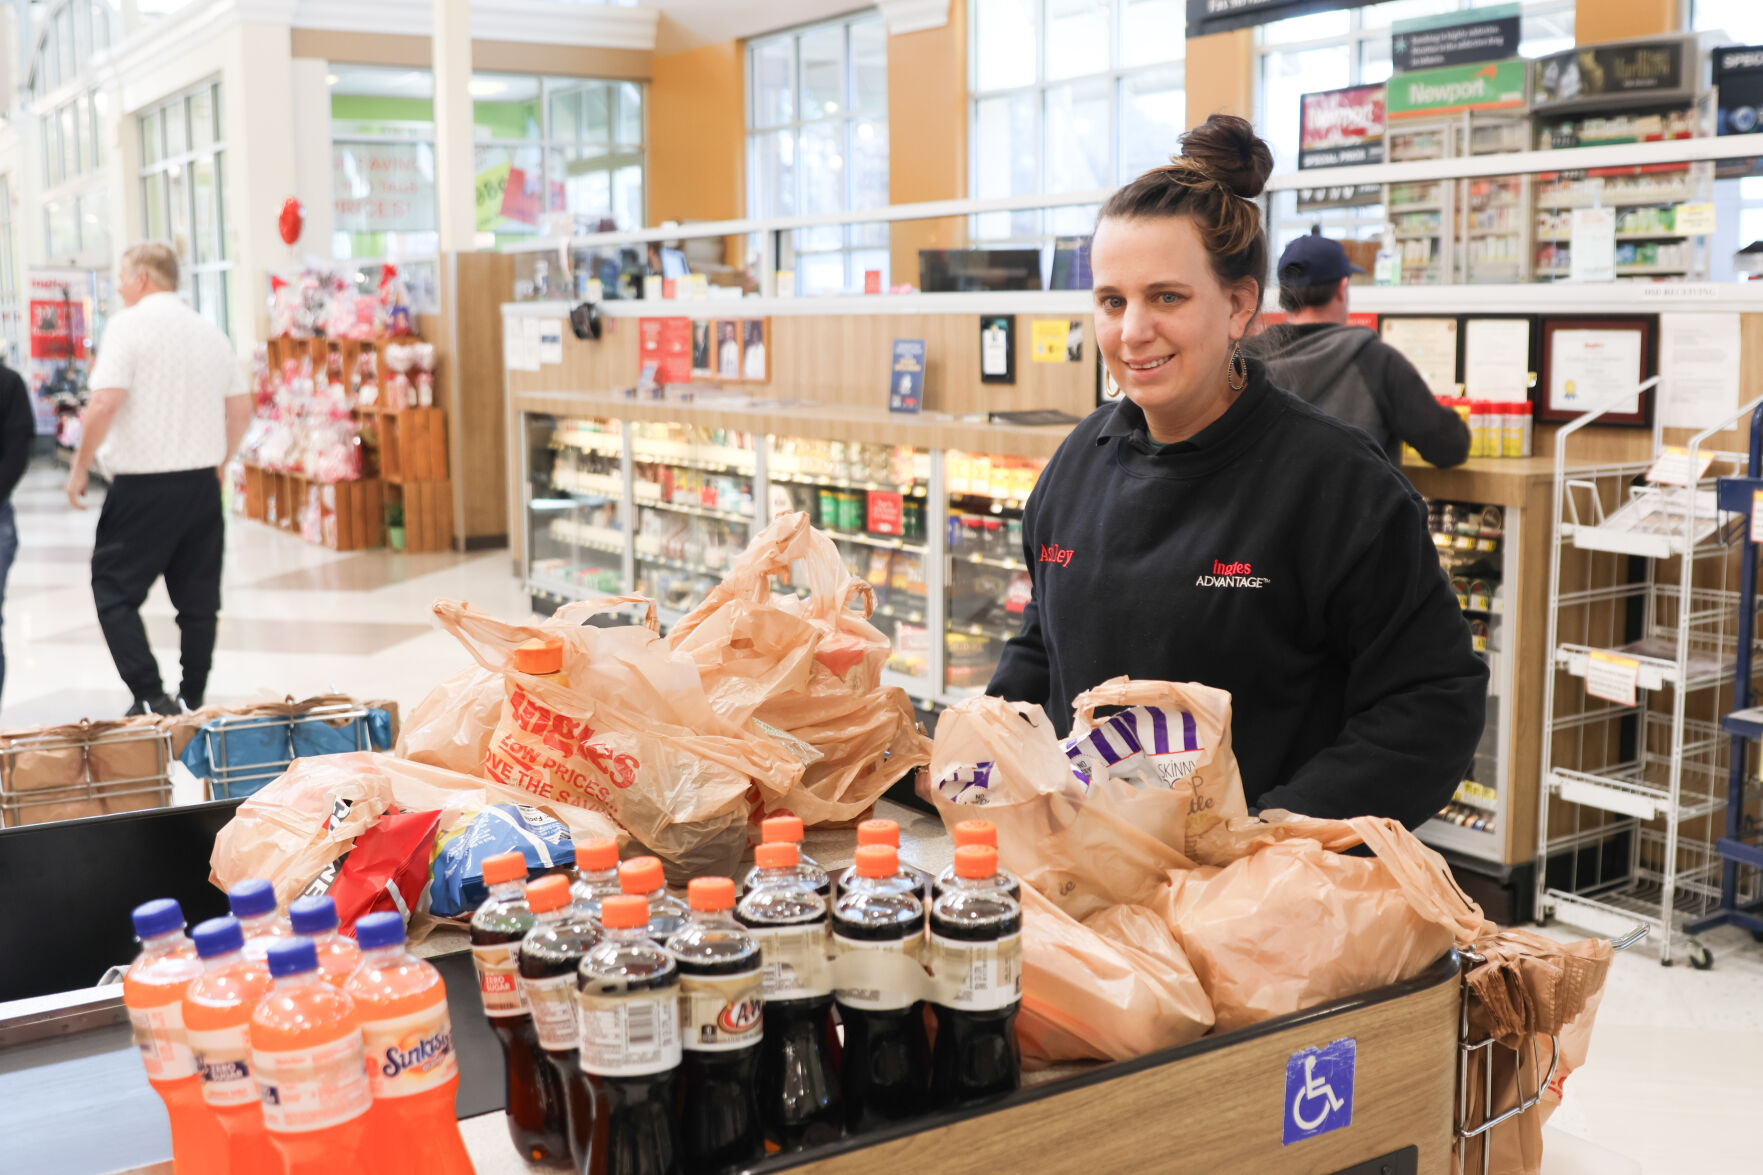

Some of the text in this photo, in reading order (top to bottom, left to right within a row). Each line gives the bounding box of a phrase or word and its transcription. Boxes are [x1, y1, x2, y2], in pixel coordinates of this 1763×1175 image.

[1409, 78, 1485, 105] Newport
[501, 733, 541, 763] LOW
[518, 770, 554, 799] THE
